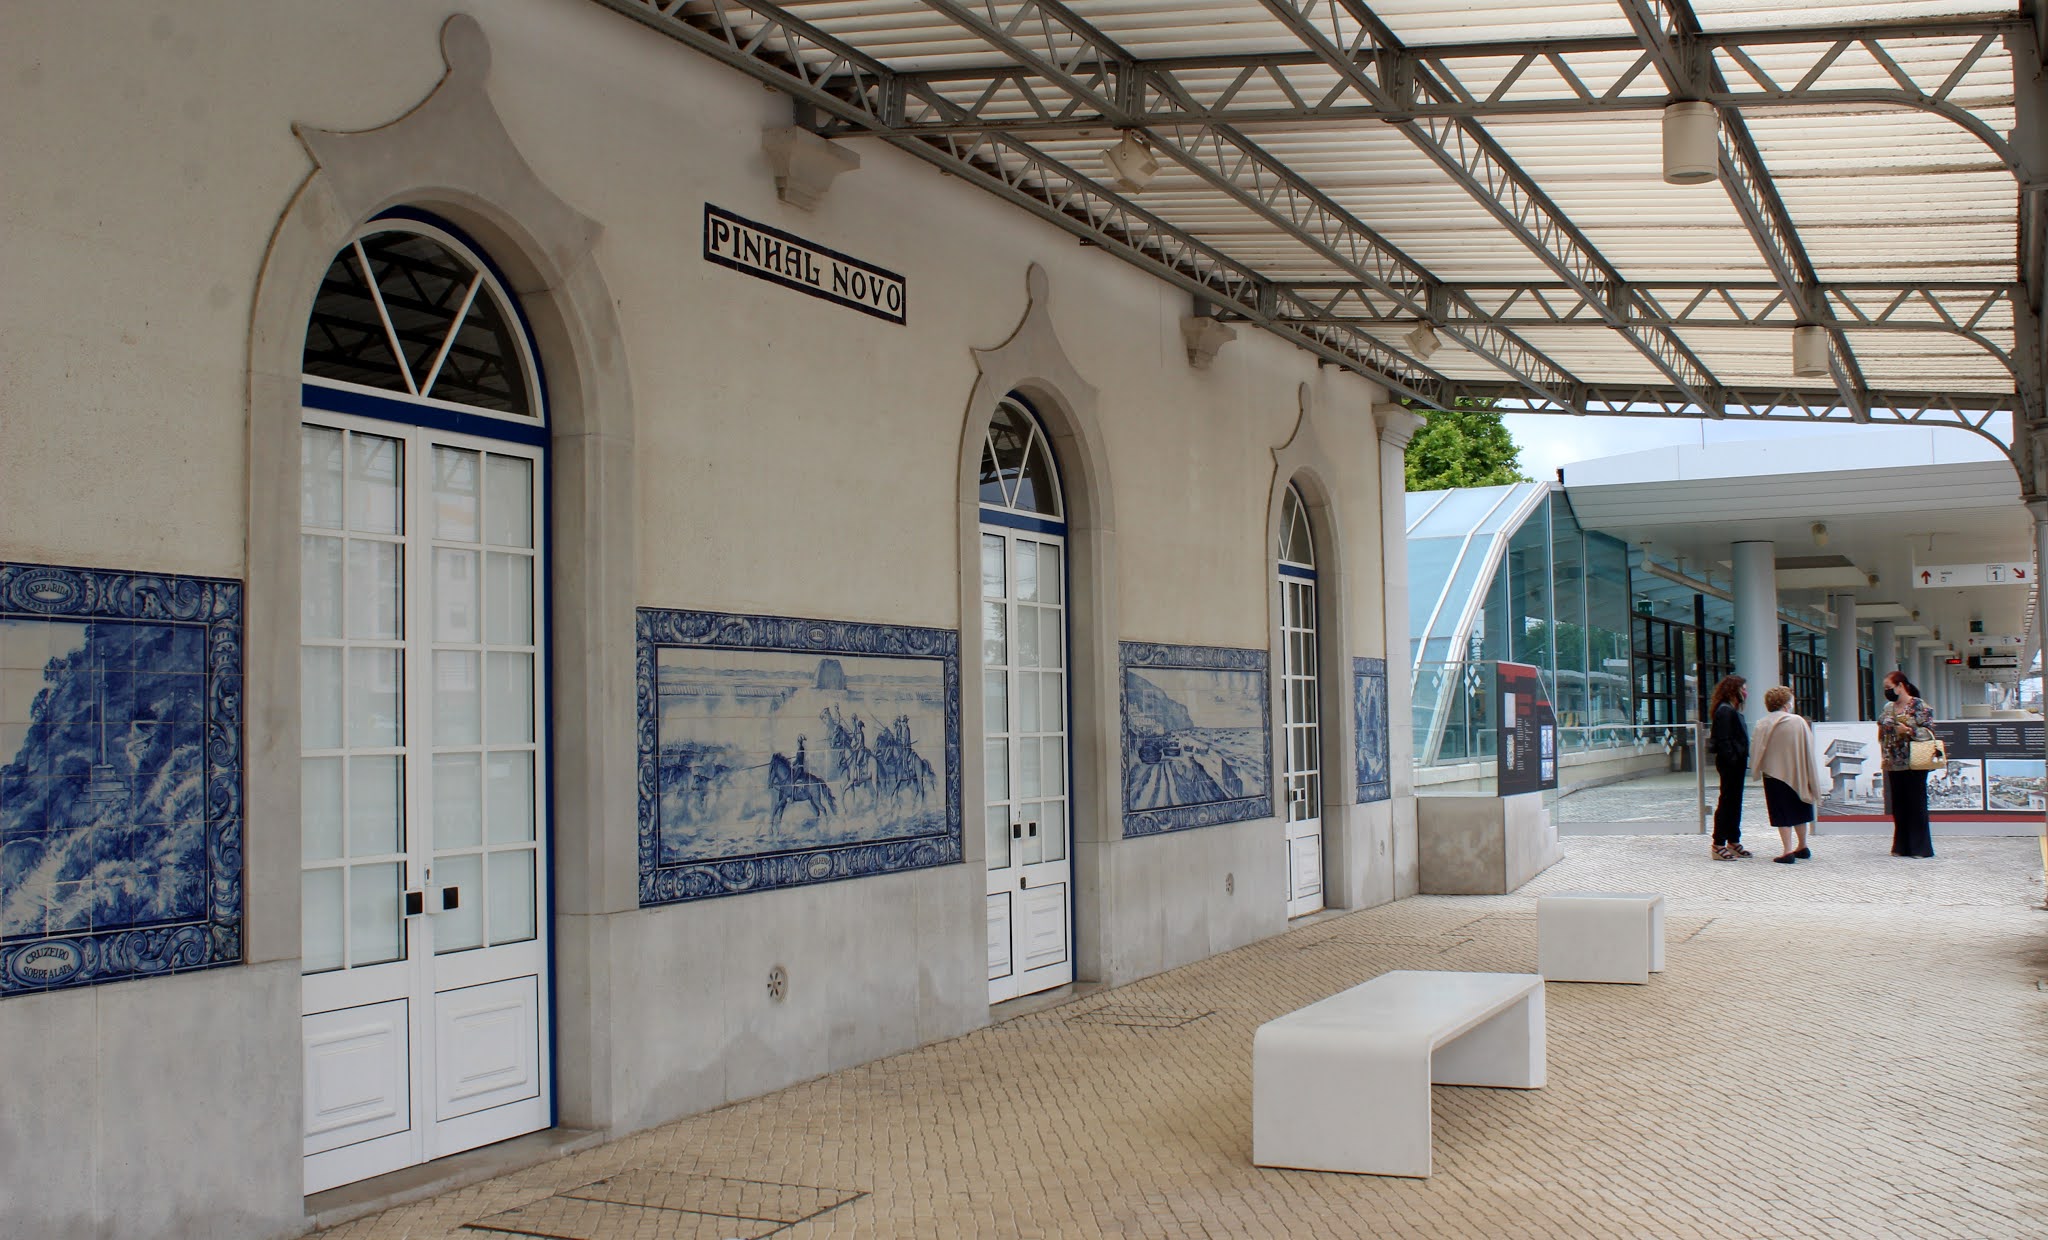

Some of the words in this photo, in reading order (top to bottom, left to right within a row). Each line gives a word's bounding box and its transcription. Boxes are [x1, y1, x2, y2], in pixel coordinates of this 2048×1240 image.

[711, 218, 820, 286] PINHAL
[832, 262, 901, 312] NOVO
[26, 947, 70, 964] CRUZEIRO
[23, 966, 48, 979] SOBRE
